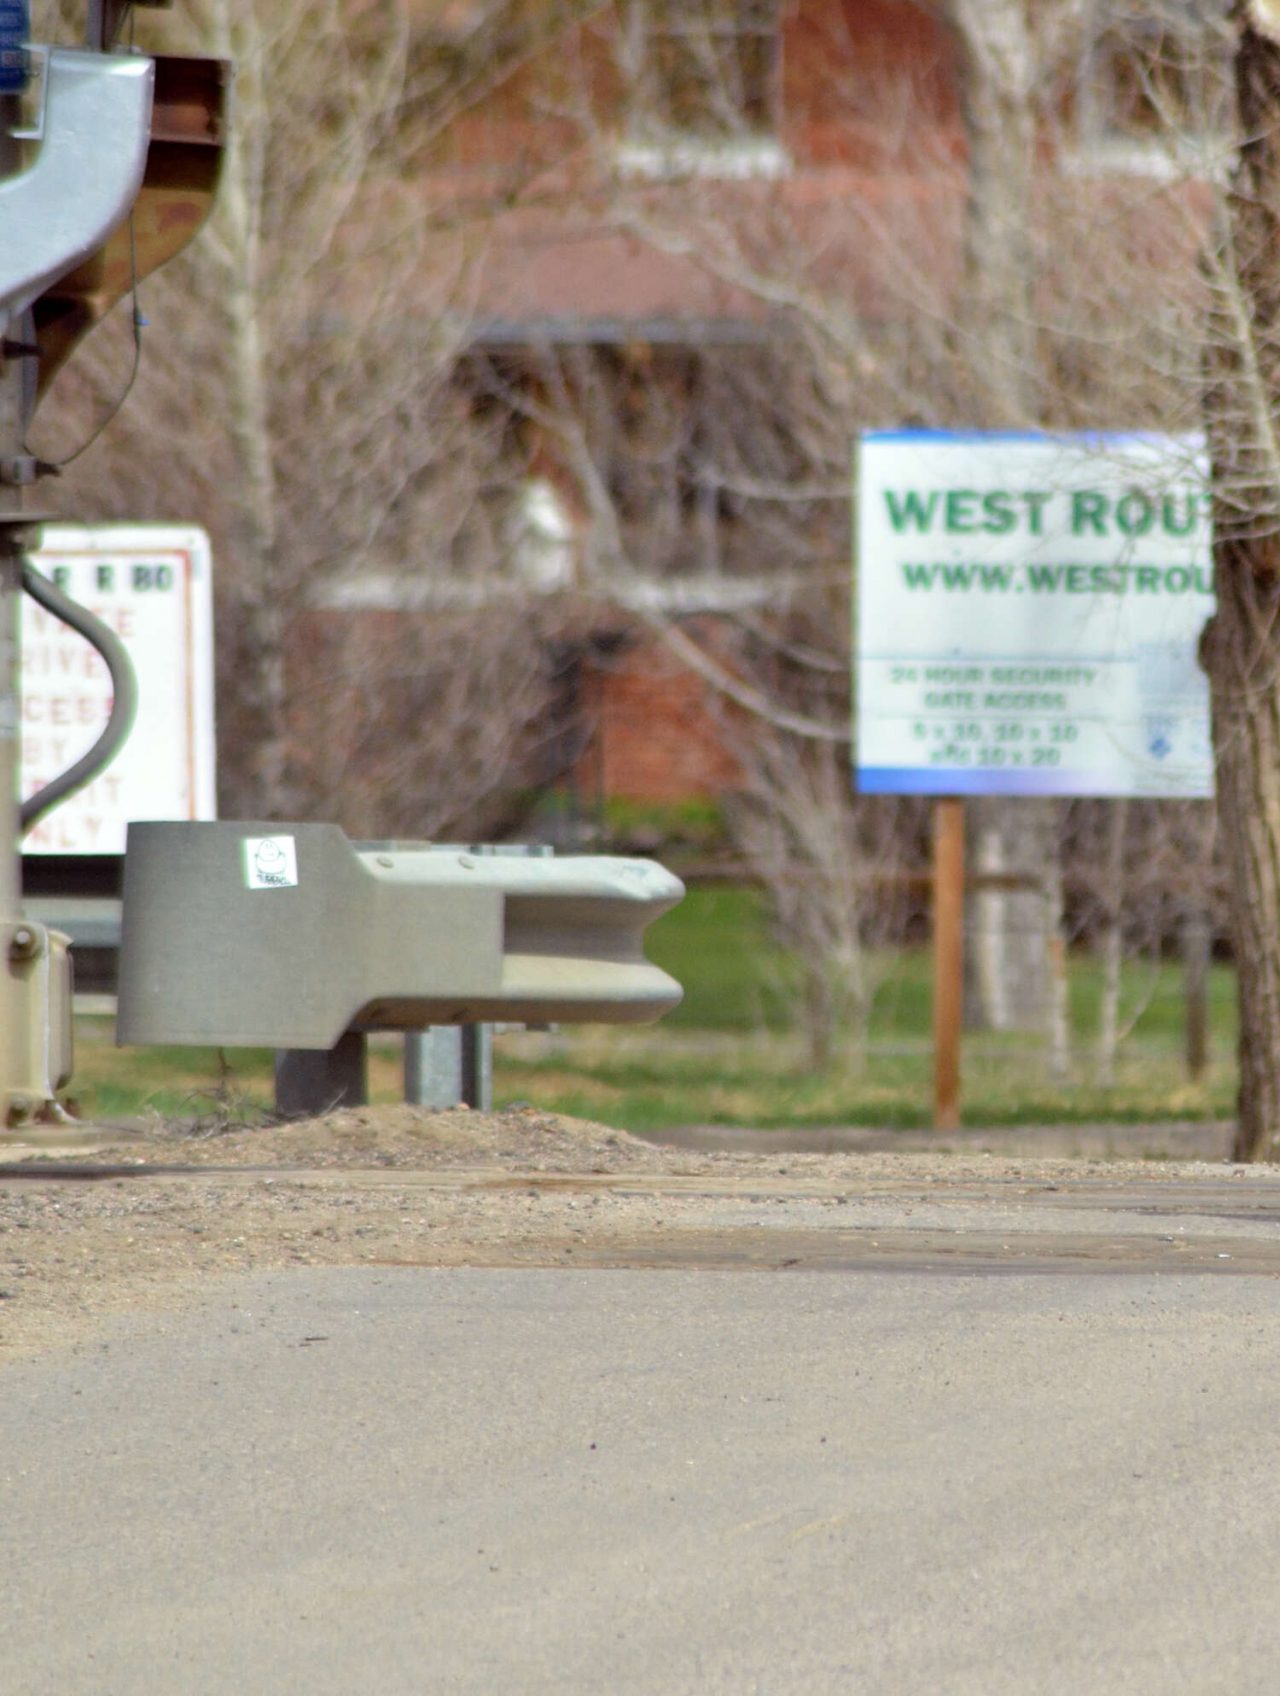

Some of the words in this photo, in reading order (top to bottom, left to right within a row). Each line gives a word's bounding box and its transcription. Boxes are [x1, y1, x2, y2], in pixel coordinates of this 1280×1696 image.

[883, 489, 1053, 535] WEST
[924, 667, 983, 685] HOUR
[990, 667, 1096, 686] SECURITY
[923, 692, 975, 709] GATE
[983, 692, 1067, 709] ACCESS
